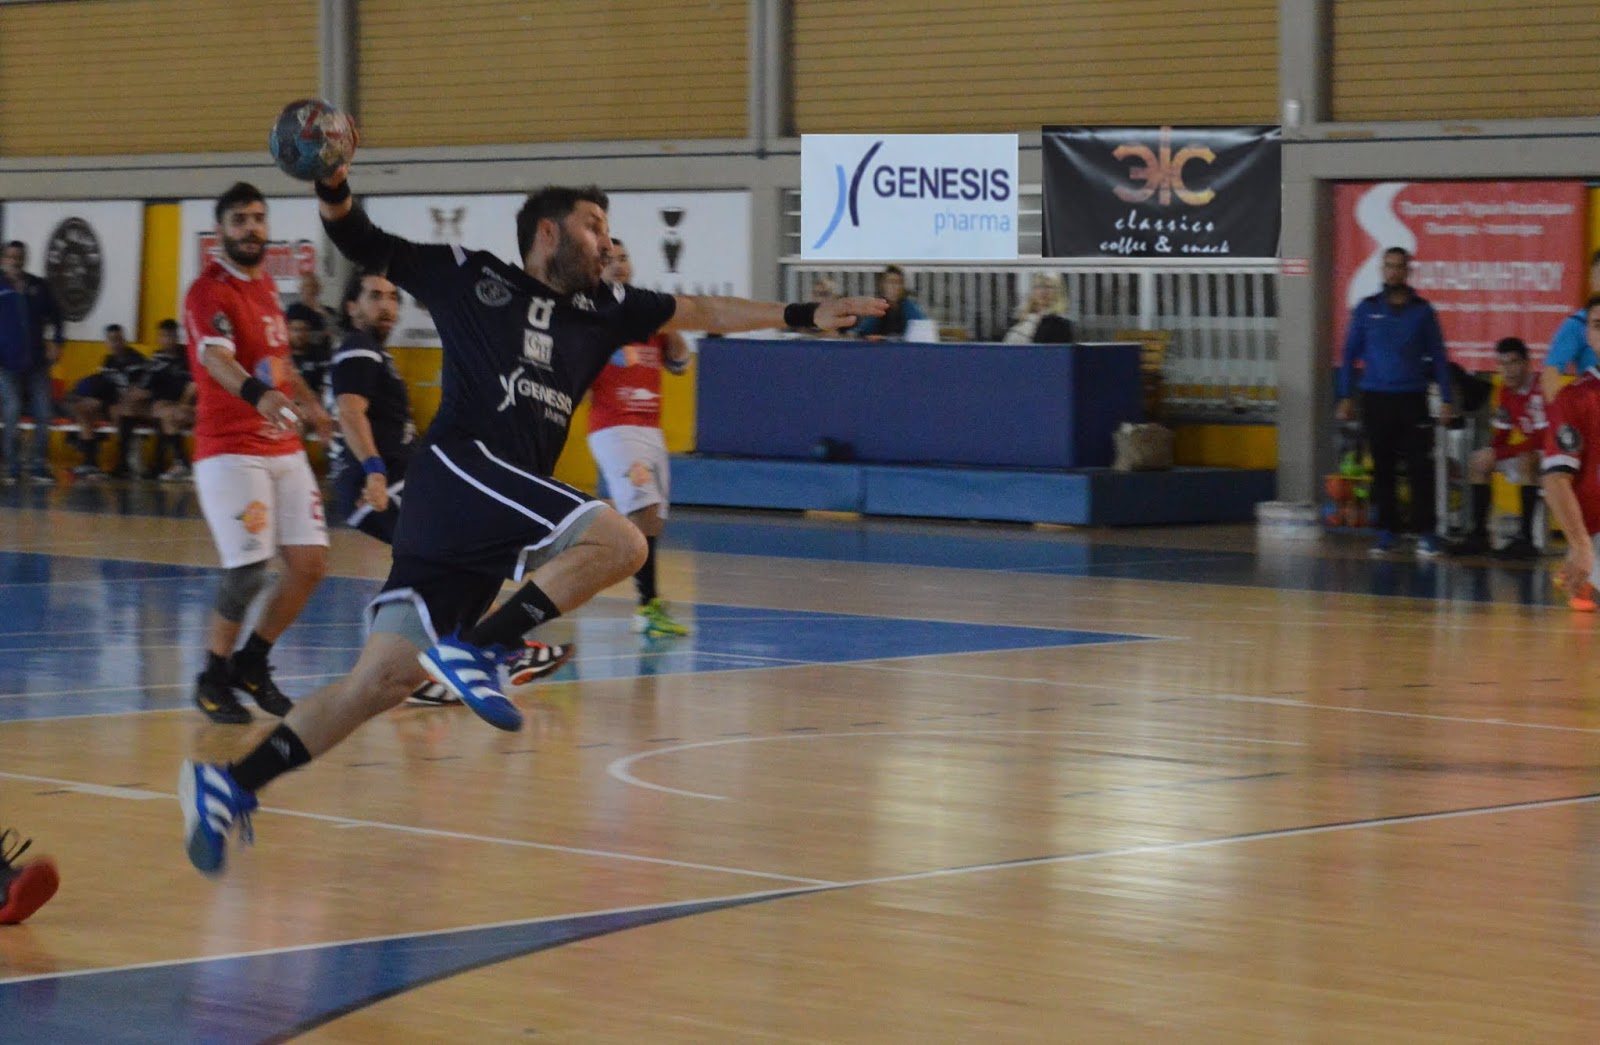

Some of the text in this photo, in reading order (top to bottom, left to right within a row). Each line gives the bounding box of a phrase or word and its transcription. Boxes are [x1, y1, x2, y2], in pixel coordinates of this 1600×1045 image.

[873, 165, 1011, 202] GENESIS
[934, 209, 1011, 235] pharma
[1100, 236, 1147, 254] coffee
[1154, 235, 1172, 253] &
